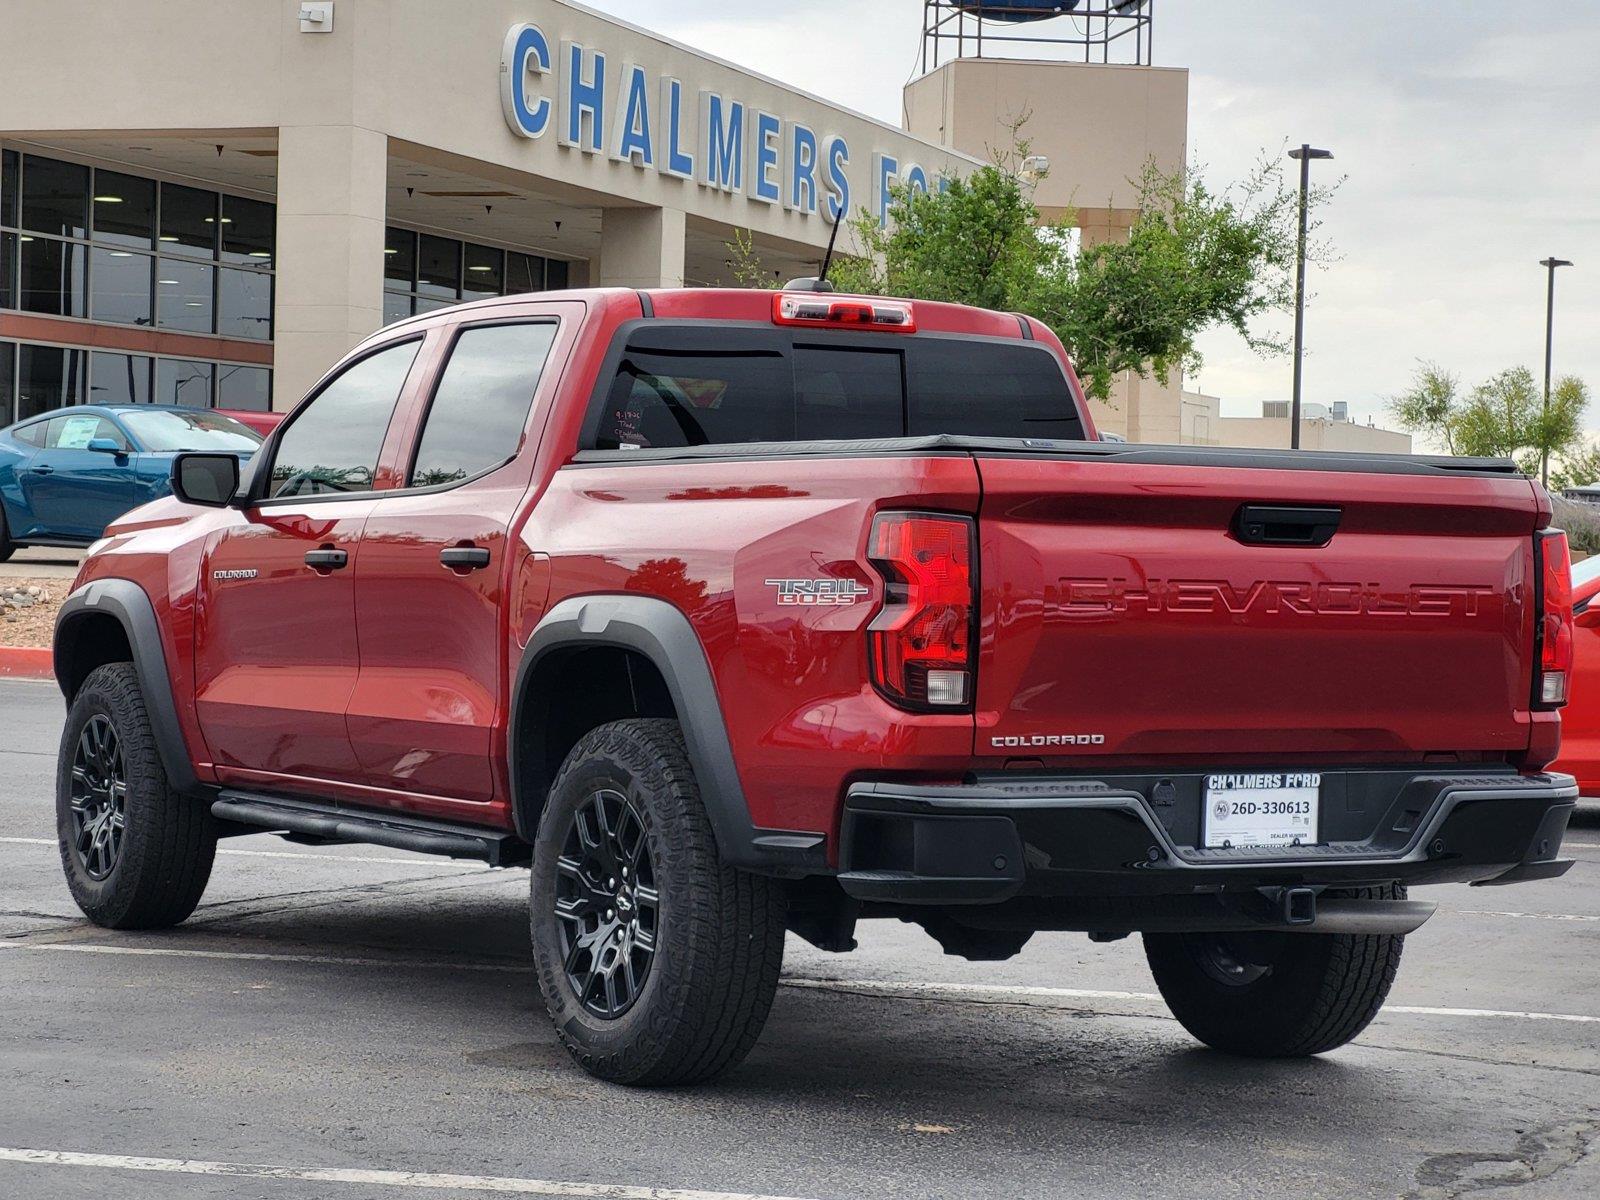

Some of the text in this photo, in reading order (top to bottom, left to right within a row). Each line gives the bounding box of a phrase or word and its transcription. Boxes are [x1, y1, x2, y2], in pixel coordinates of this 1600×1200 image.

[500, 22, 850, 225] CHALMERS
[213, 569, 257, 579] COLORADO
[764, 578, 869, 595] TRAIL
[776, 593, 856, 606] BOSS
[1058, 576, 1494, 618] CHEVROLET
[991, 734, 1105, 747] COLORADO
[1208, 774, 1282, 789] CHALMERS
[1231, 801, 1310, 815] 26D-330613
